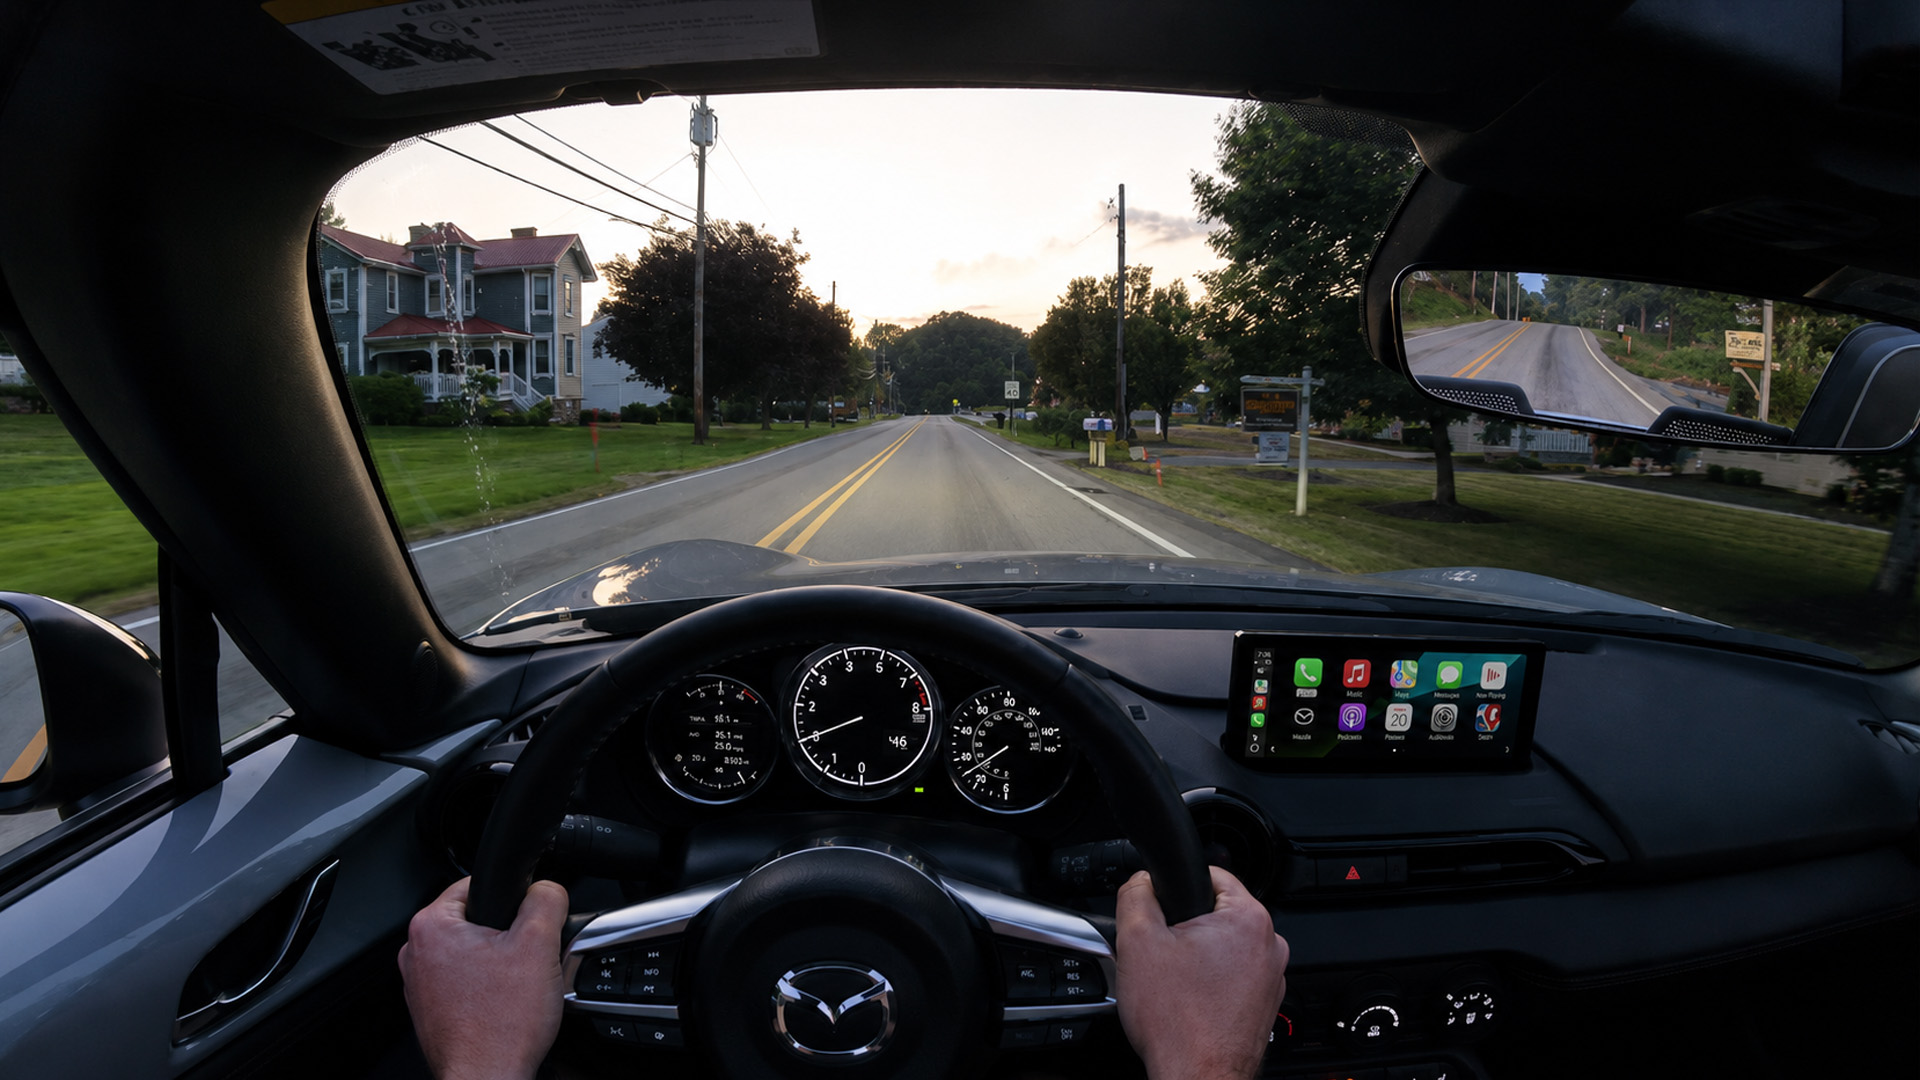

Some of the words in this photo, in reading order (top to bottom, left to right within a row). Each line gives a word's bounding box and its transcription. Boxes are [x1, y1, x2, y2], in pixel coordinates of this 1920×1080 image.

[900, 677, 907, 688] 7
[808, 701, 816, 712] 2
[912, 702, 920, 713] 8
[1391, 713, 1408, 727] 20
[832, 753, 837, 763] 1
[858, 762, 866, 773] 0
